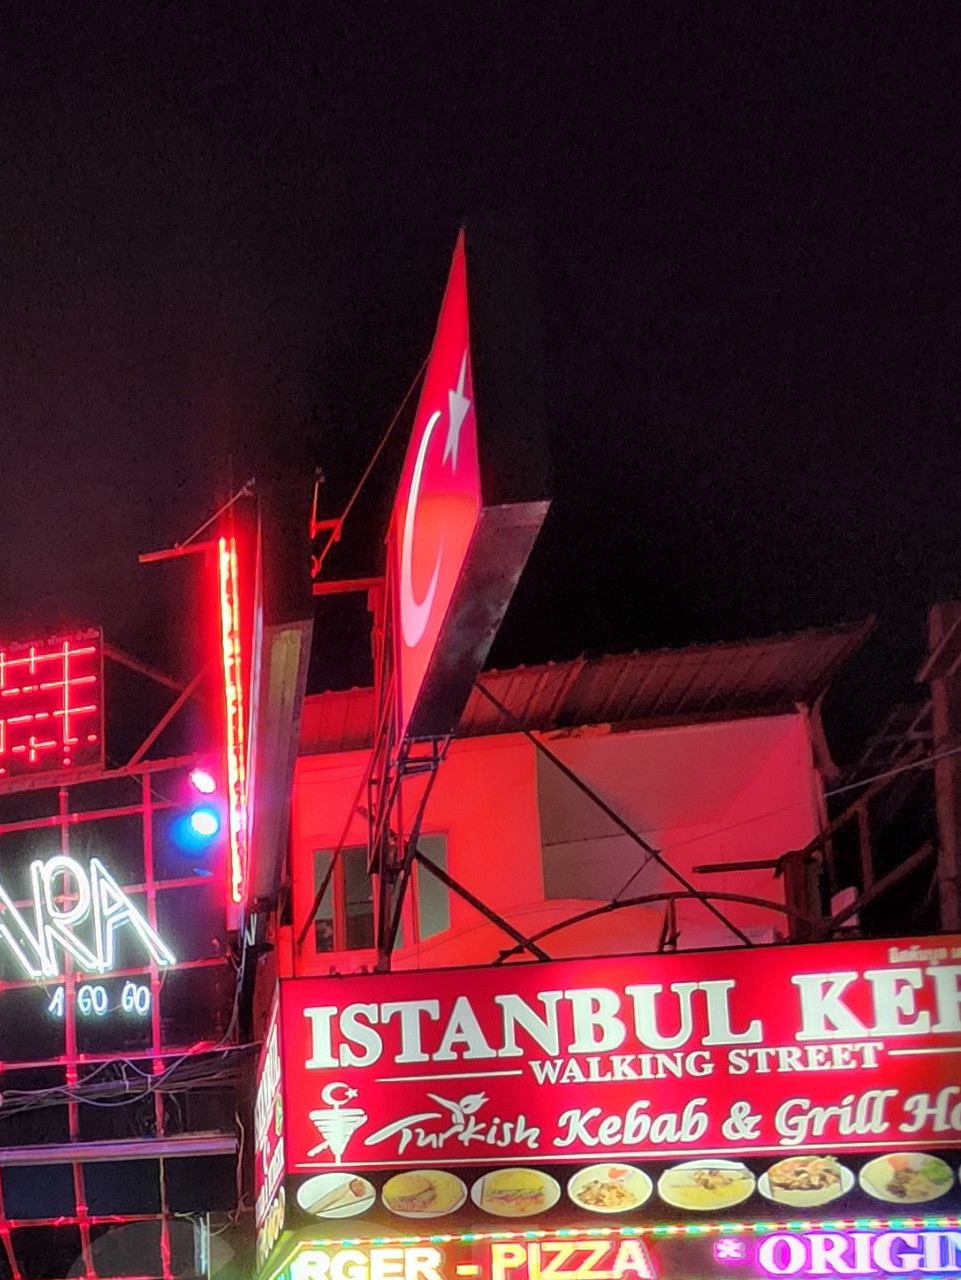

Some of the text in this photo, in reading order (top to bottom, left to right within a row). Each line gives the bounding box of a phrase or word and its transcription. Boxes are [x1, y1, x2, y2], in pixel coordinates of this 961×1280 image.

[48, 981, 151, 1016] A GO GO
[304, 979, 762, 1069] ISTANBUL
[529, 1042, 884, 1085] WALKING STREET
[364, 1092, 541, 1155] Turkish
[553, 1097, 709, 1147] Kebab
[722, 1100, 761, 1141] &
[775, 1088, 899, 1146] Grill
